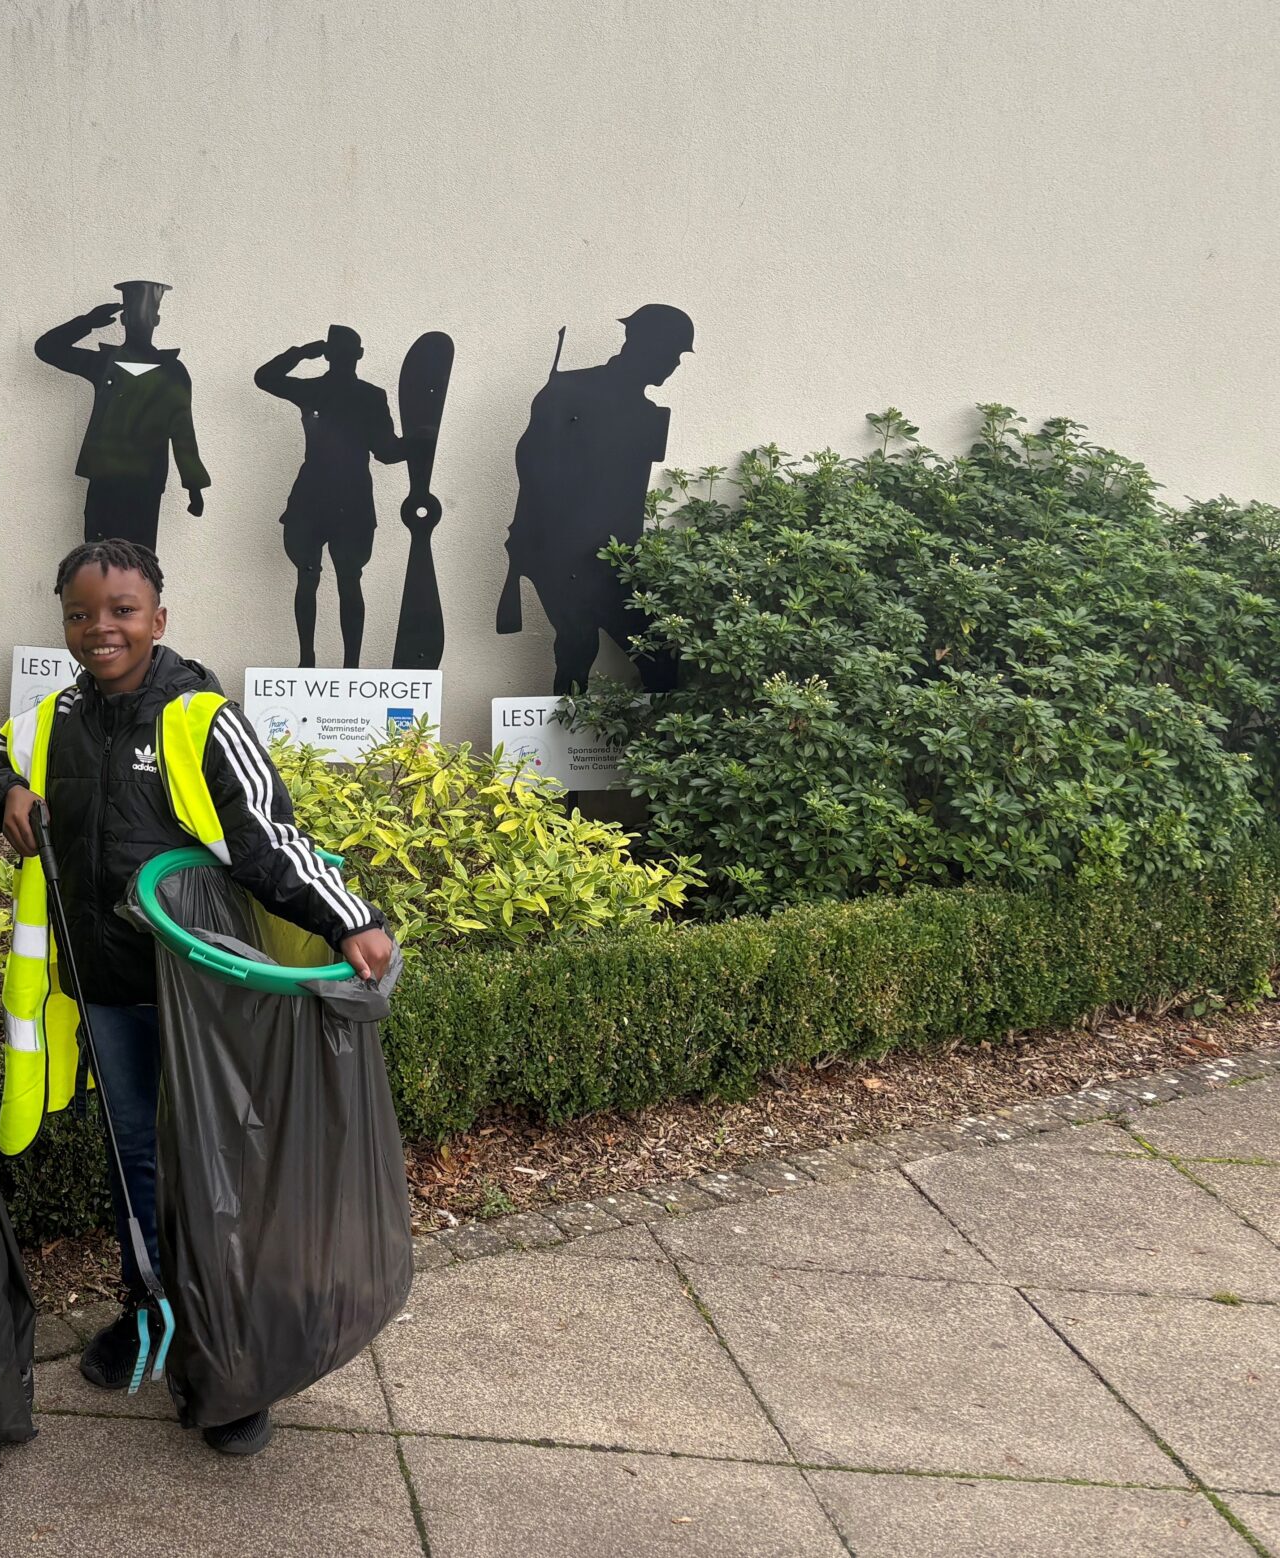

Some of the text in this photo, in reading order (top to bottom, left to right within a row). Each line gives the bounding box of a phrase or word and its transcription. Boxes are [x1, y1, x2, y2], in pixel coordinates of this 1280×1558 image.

[21, 657, 62, 677] LEST
[254, 679, 433, 700] LEST WE FORGET
[316, 716, 371, 726] Sponsored by
[502, 708, 547, 727] LEST
[321, 724, 366, 733] Warminster
[317, 732, 370, 741] Town Council
[567, 746, 623, 755] Sponsored by
[572, 755, 617, 763] Warminster
[132, 763, 157, 774] adidas
[569, 763, 618, 771] Town Counc
